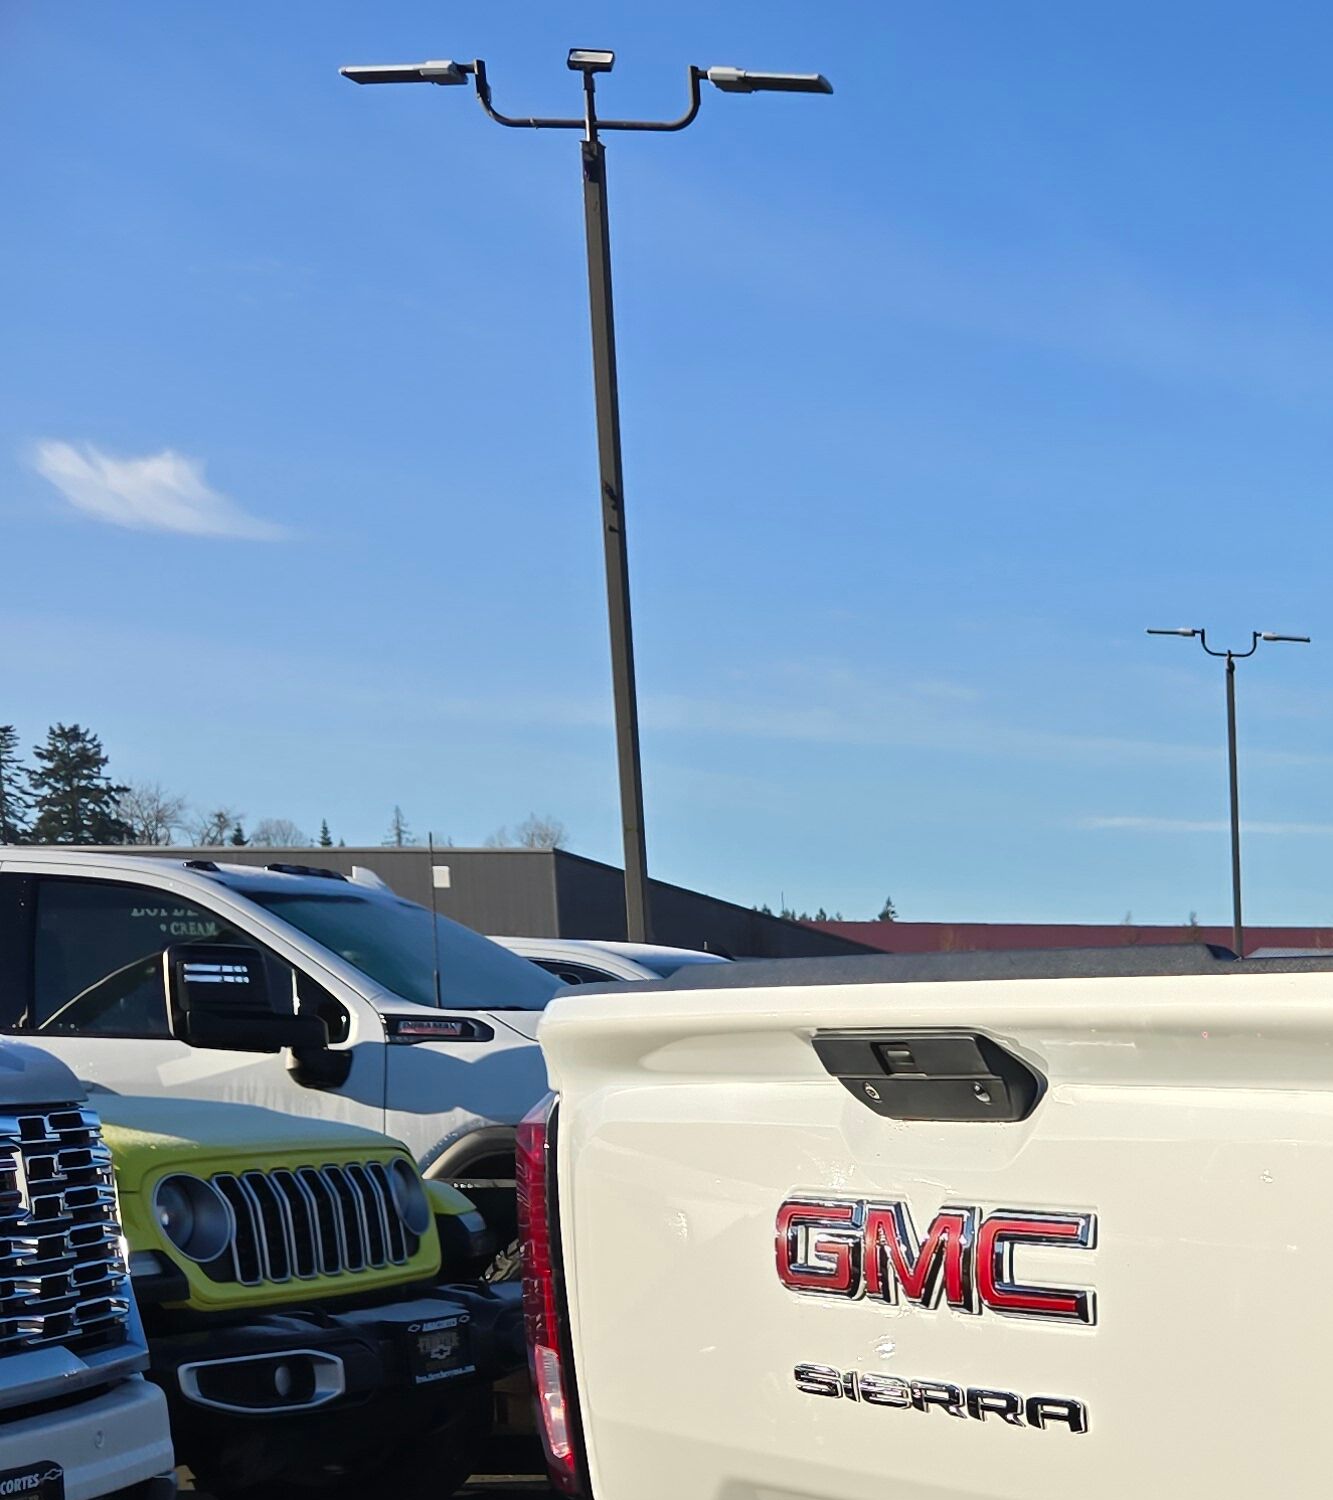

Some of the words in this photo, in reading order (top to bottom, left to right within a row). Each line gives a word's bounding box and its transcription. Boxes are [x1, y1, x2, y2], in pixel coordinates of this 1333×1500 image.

[170, 921, 218, 936] CREAM
[775, 1198, 1098, 1326] GMC
[793, 1362, 1089, 1434] SIERRA
